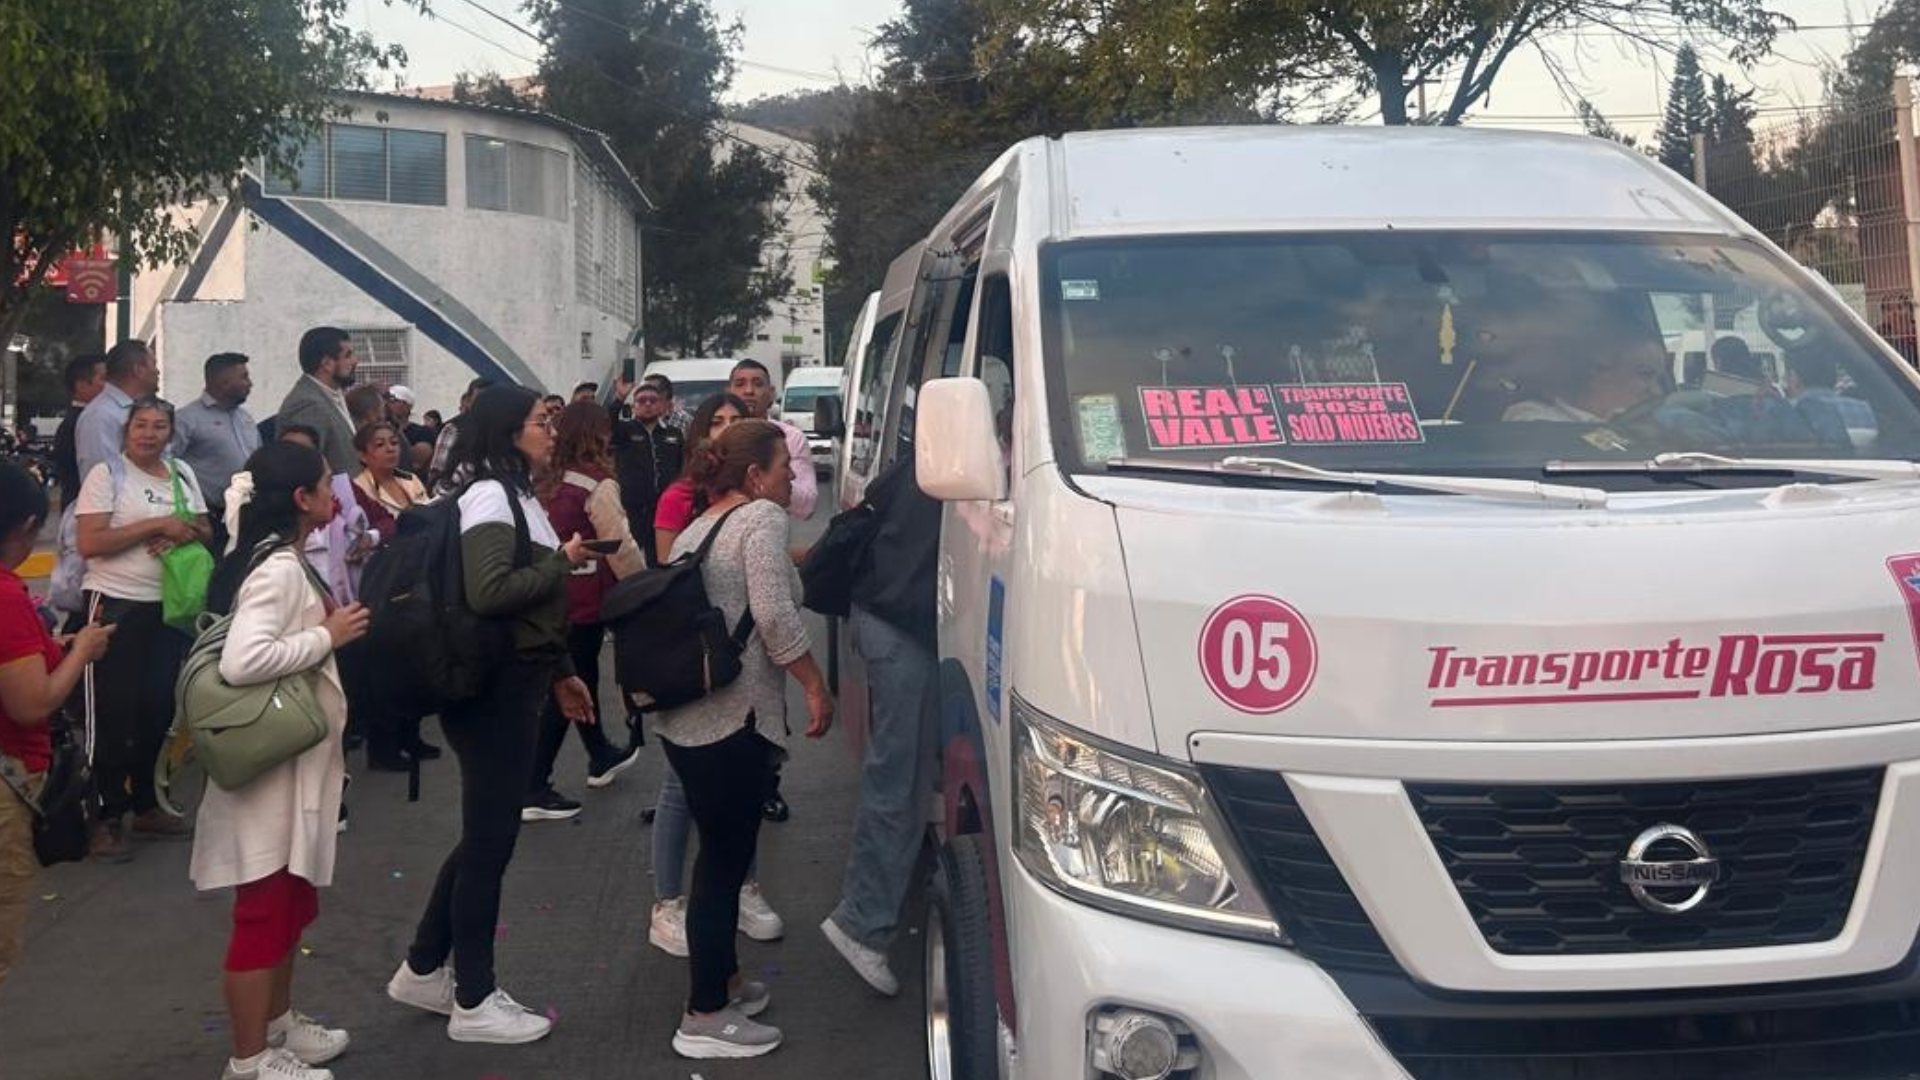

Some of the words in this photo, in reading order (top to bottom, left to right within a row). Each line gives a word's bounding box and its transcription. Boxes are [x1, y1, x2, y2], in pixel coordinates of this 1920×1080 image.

[1142, 388, 1263, 416] REAL
[1280, 387, 1407, 403] TRANSPORTE
[1304, 401, 1388, 413] ROSA
[1149, 415, 1280, 445] VALLE
[1287, 413, 1335, 441] SOLO
[1335, 412, 1418, 440] MUJERES
[1221, 618, 1291, 691] 05
[1427, 637, 1711, 690] Transporte
[1710, 634, 1879, 698] Rosa
